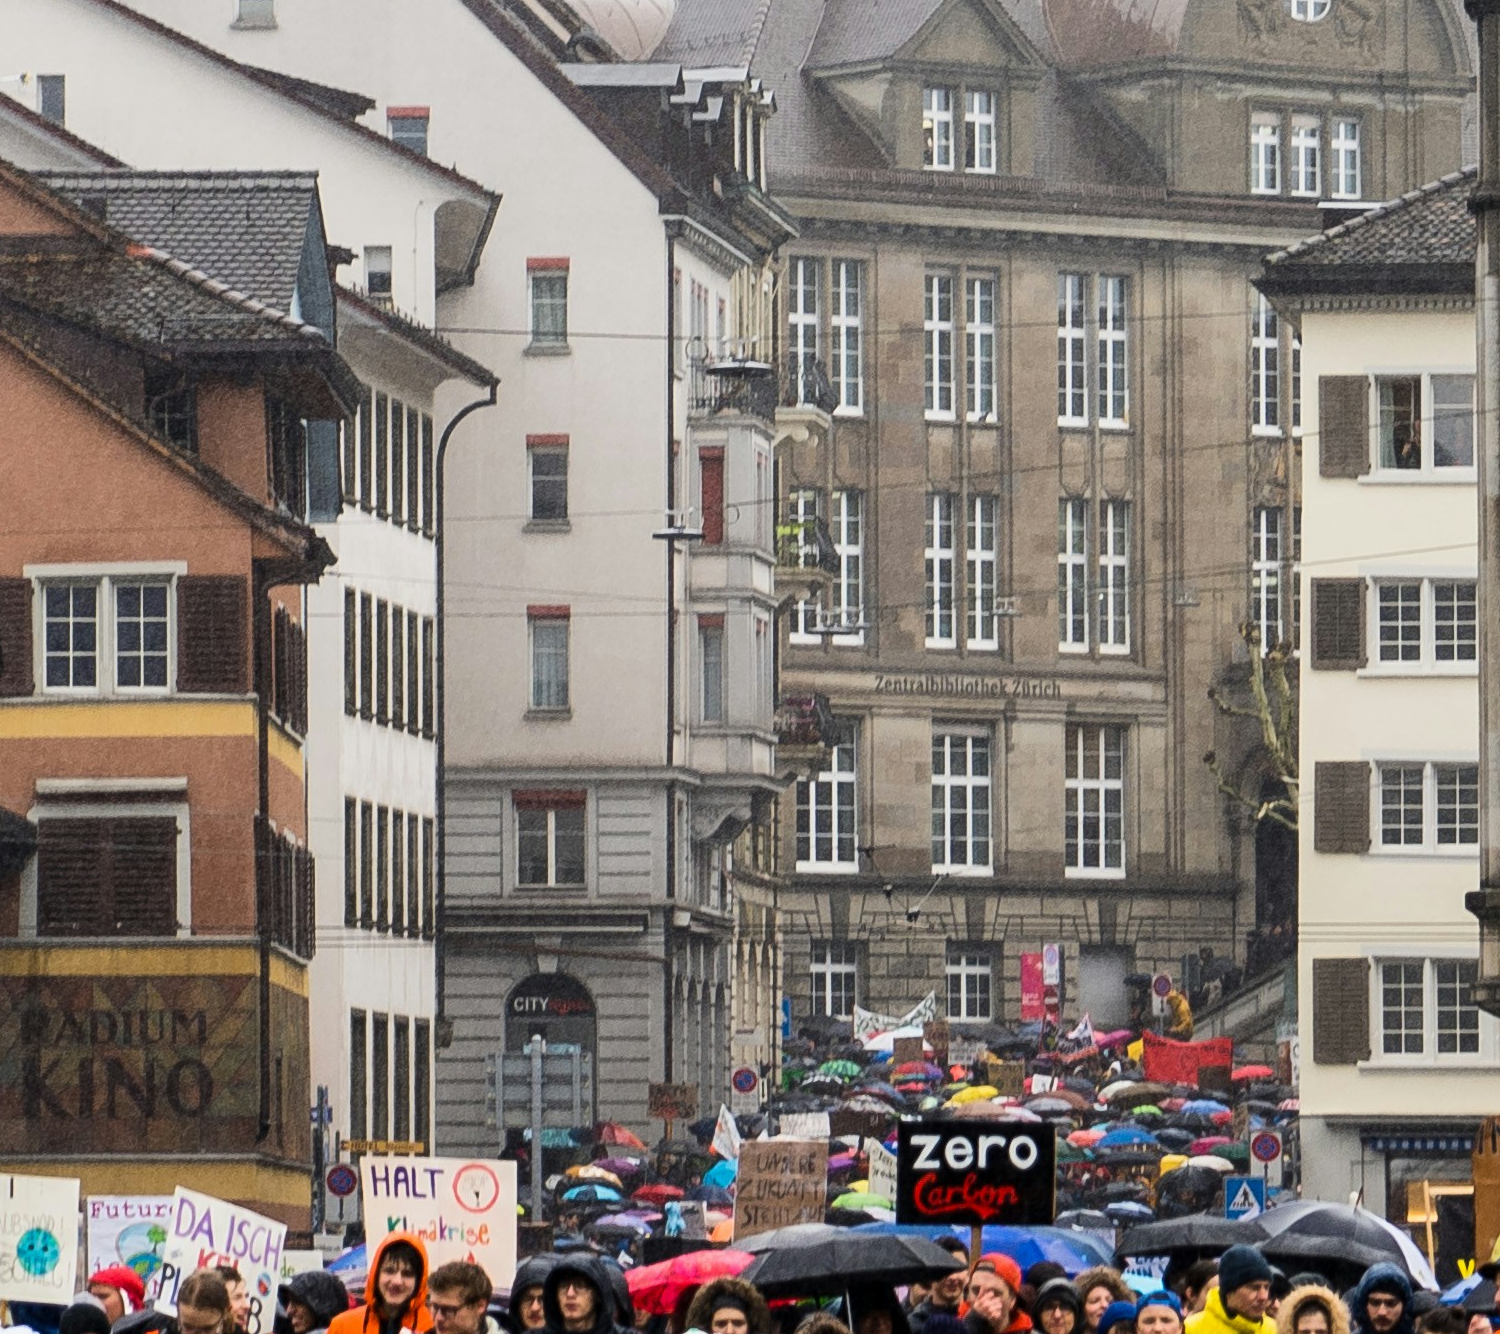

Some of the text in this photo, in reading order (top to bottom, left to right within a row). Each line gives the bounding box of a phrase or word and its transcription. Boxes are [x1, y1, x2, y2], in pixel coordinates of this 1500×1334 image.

[22, 1009, 207, 1047] RADIUM
[24, 1057, 214, 1120] KINO
[910, 1134, 1038, 1170] zero
[370, 1165, 444, 1198] HALT
[915, 1172, 1019, 1220] Carbon
[175, 1197, 283, 1272] DA ISCH
